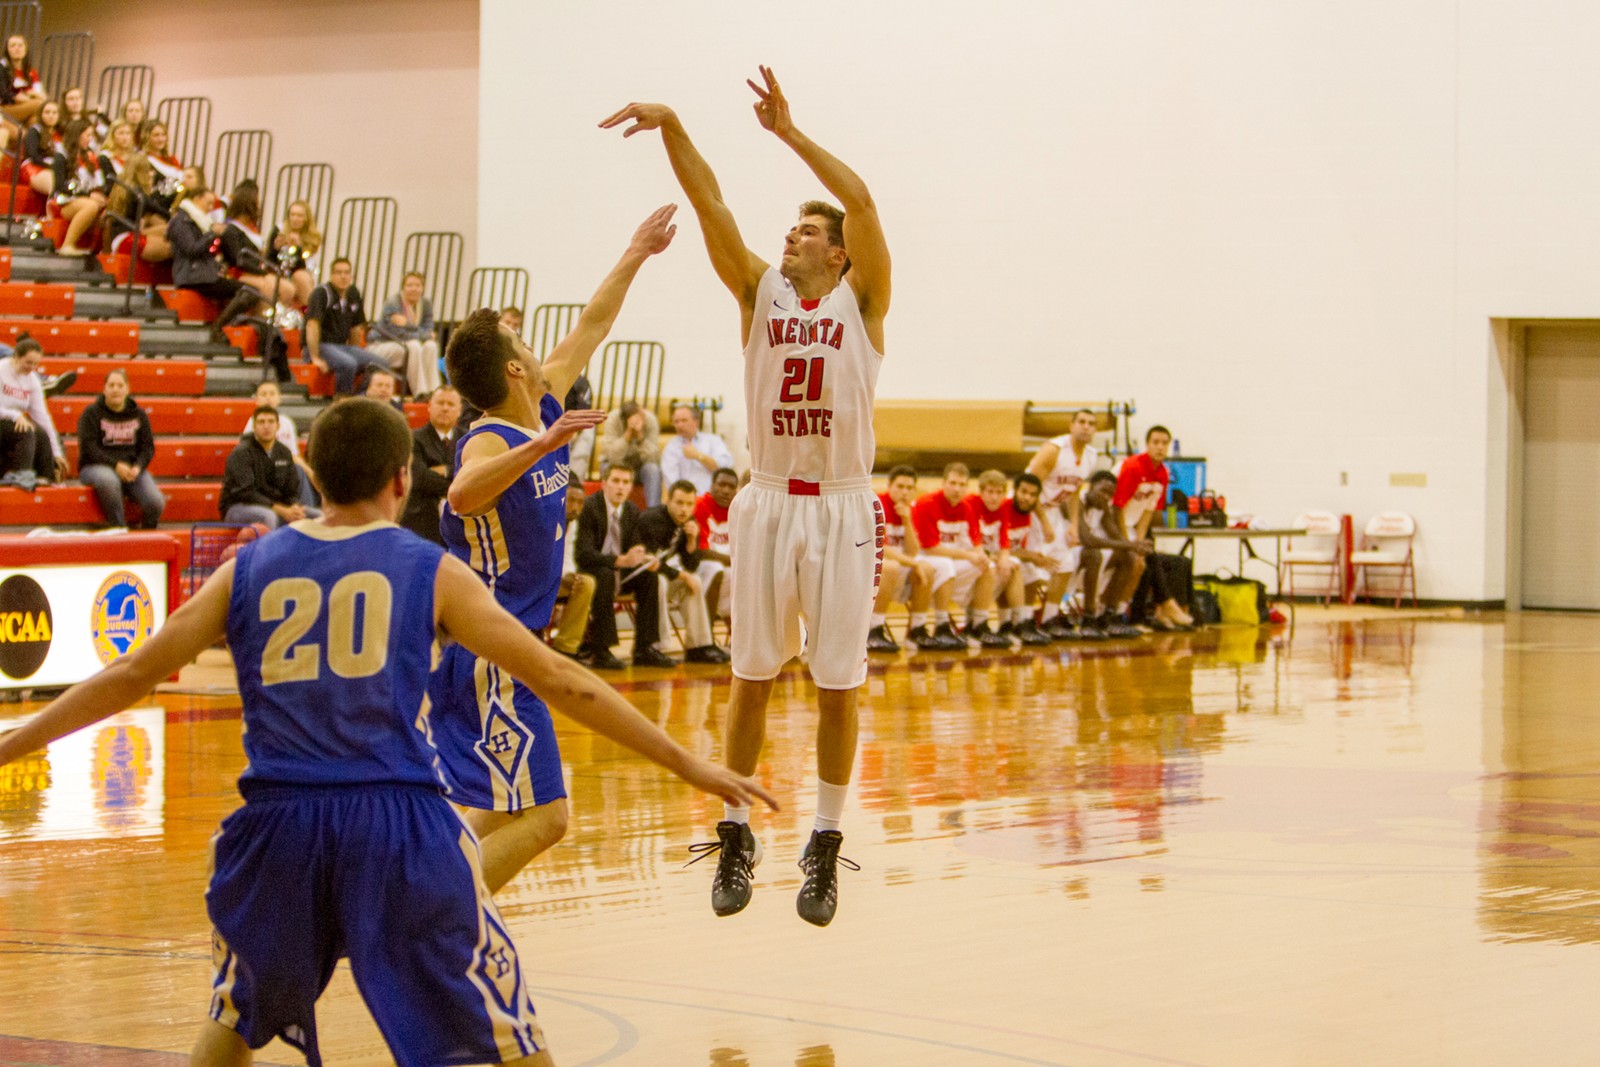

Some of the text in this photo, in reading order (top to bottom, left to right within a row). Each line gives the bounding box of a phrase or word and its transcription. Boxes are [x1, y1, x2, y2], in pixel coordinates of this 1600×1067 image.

[767, 317, 844, 350] NEONTA
[780, 357, 824, 403] 21
[772, 409, 833, 437] STATE
[259, 570, 392, 686] 20
[491, 731, 512, 754] H
